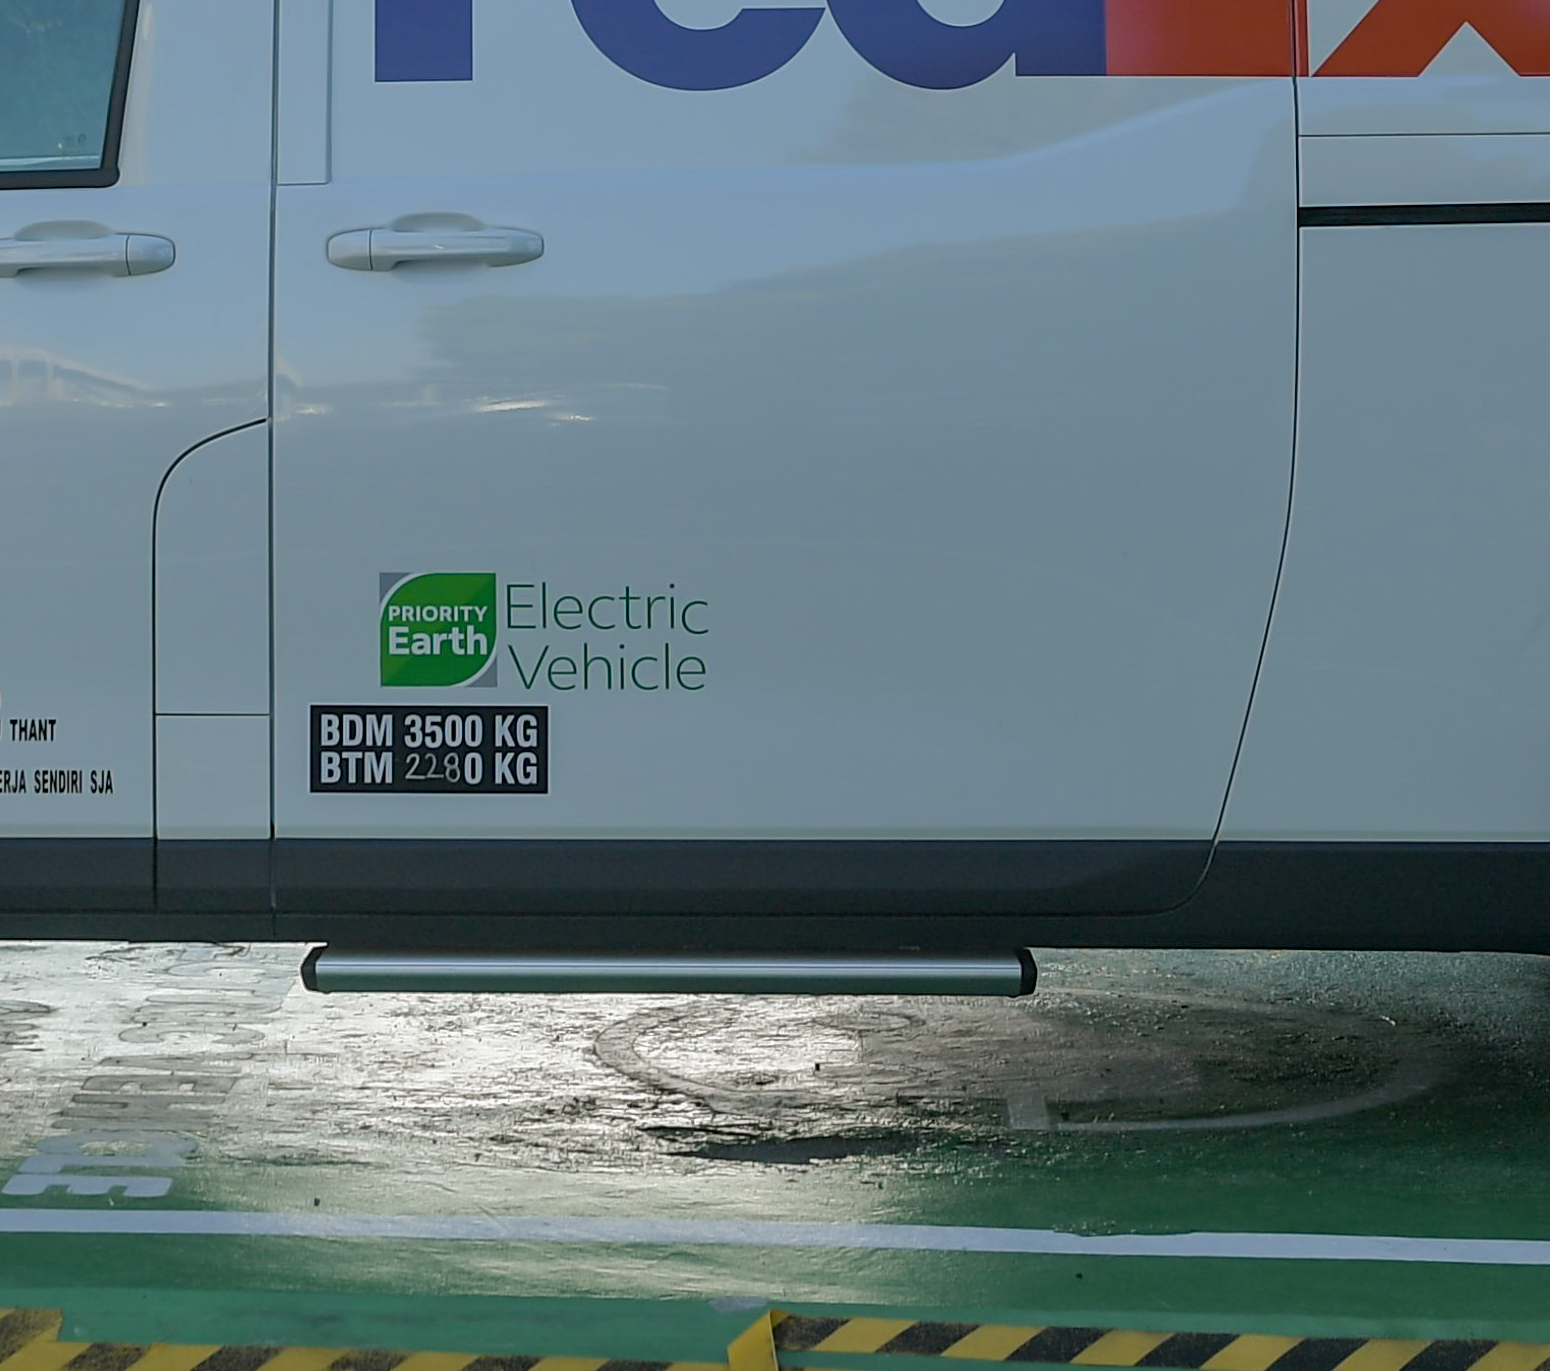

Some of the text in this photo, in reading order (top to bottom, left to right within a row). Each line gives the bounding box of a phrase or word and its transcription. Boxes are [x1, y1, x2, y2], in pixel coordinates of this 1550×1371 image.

[387, 605, 488, 623] PRIORITY
[506, 581, 709, 635] Electric
[387, 624, 488, 656] Earth
[507, 642, 707, 691] Vehicle
[9, 718, 57, 742] THANT
[320, 714, 538, 748] BDM 3500 KG
[34, 769, 83, 794] SENDIRI
[90, 769, 114, 794] SJA
[320, 751, 538, 785] BTM 2280 KG
